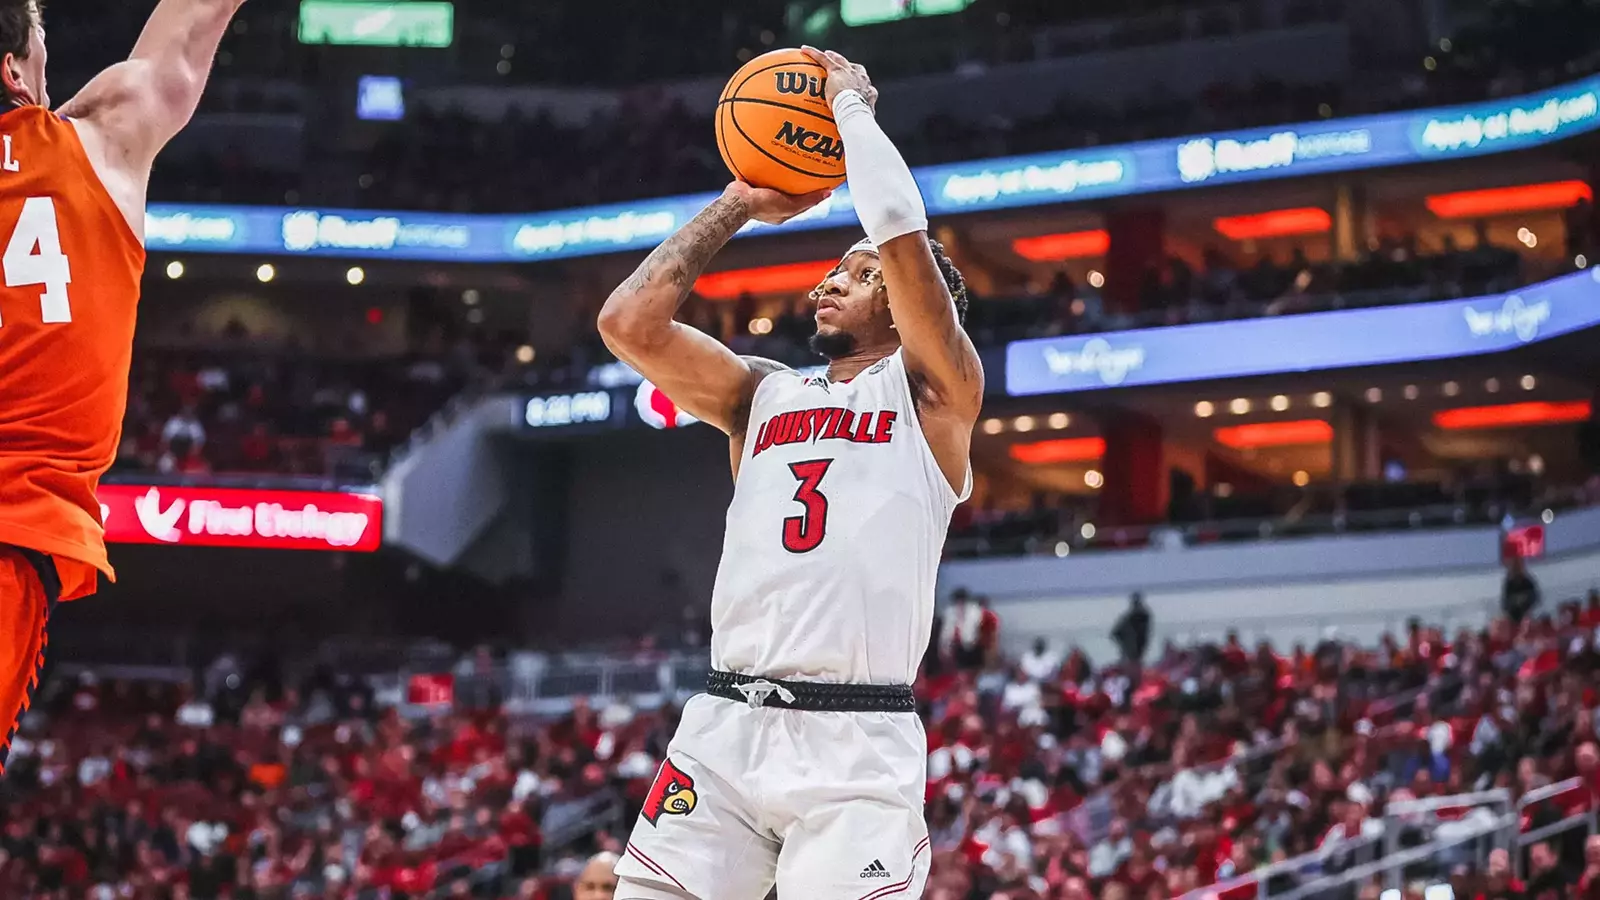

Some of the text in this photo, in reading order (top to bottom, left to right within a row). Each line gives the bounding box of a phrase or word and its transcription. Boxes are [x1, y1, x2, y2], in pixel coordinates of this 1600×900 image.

[774, 71, 827, 100] Wil
[0, 134, 19, 172] L
[771, 139, 837, 167] OFFICIAL GAME BALL
[774, 121, 844, 161] NCAA
[0, 196, 72, 328] 4
[752, 407, 897, 459] LOUISVILLE
[782, 458, 835, 553] 3
[859, 870, 891, 879] adidas
